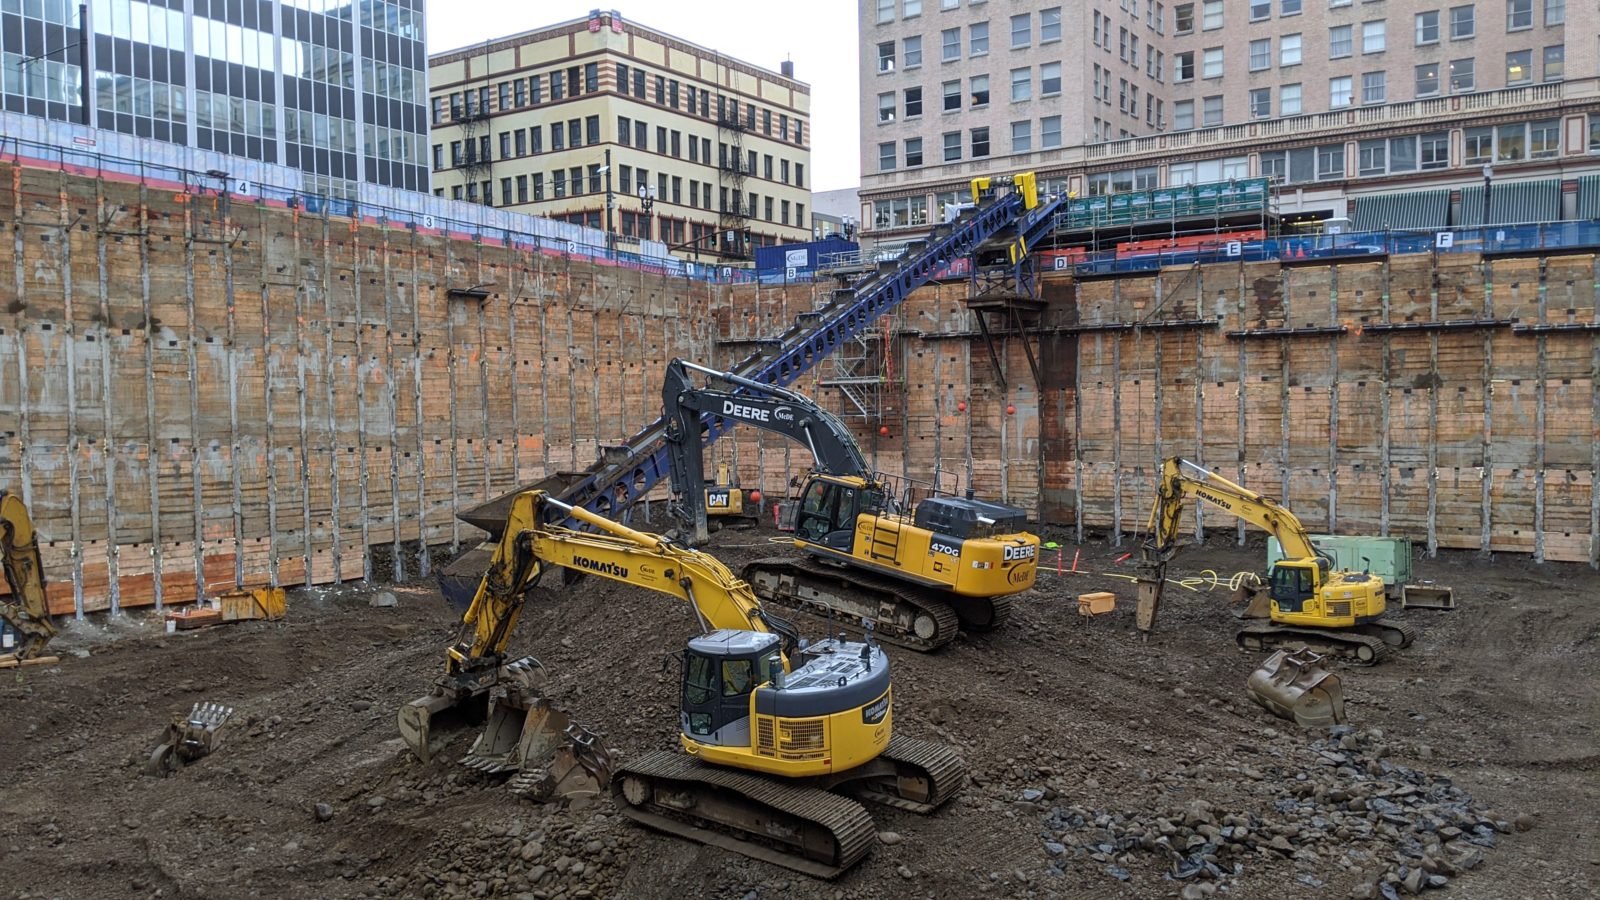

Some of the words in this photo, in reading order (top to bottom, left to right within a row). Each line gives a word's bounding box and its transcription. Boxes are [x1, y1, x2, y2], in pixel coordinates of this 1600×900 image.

[239, 182, 247, 193] 4
[426, 216, 432, 227] 3
[1440, 234, 1449, 246] F
[569, 243, 575, 253] 2
[1230, 243, 1239, 255] E
[1057, 258, 1065, 269] D
[788, 269, 795, 278] B
[722, 400, 770, 422] DEERE
[709, 493, 728, 506] CAT
[1195, 489, 1232, 510] KOMATSU
[931, 543, 959, 557] 470G
[1003, 545, 1035, 561] DEERE
[573, 555, 629, 578] KOMATSU
